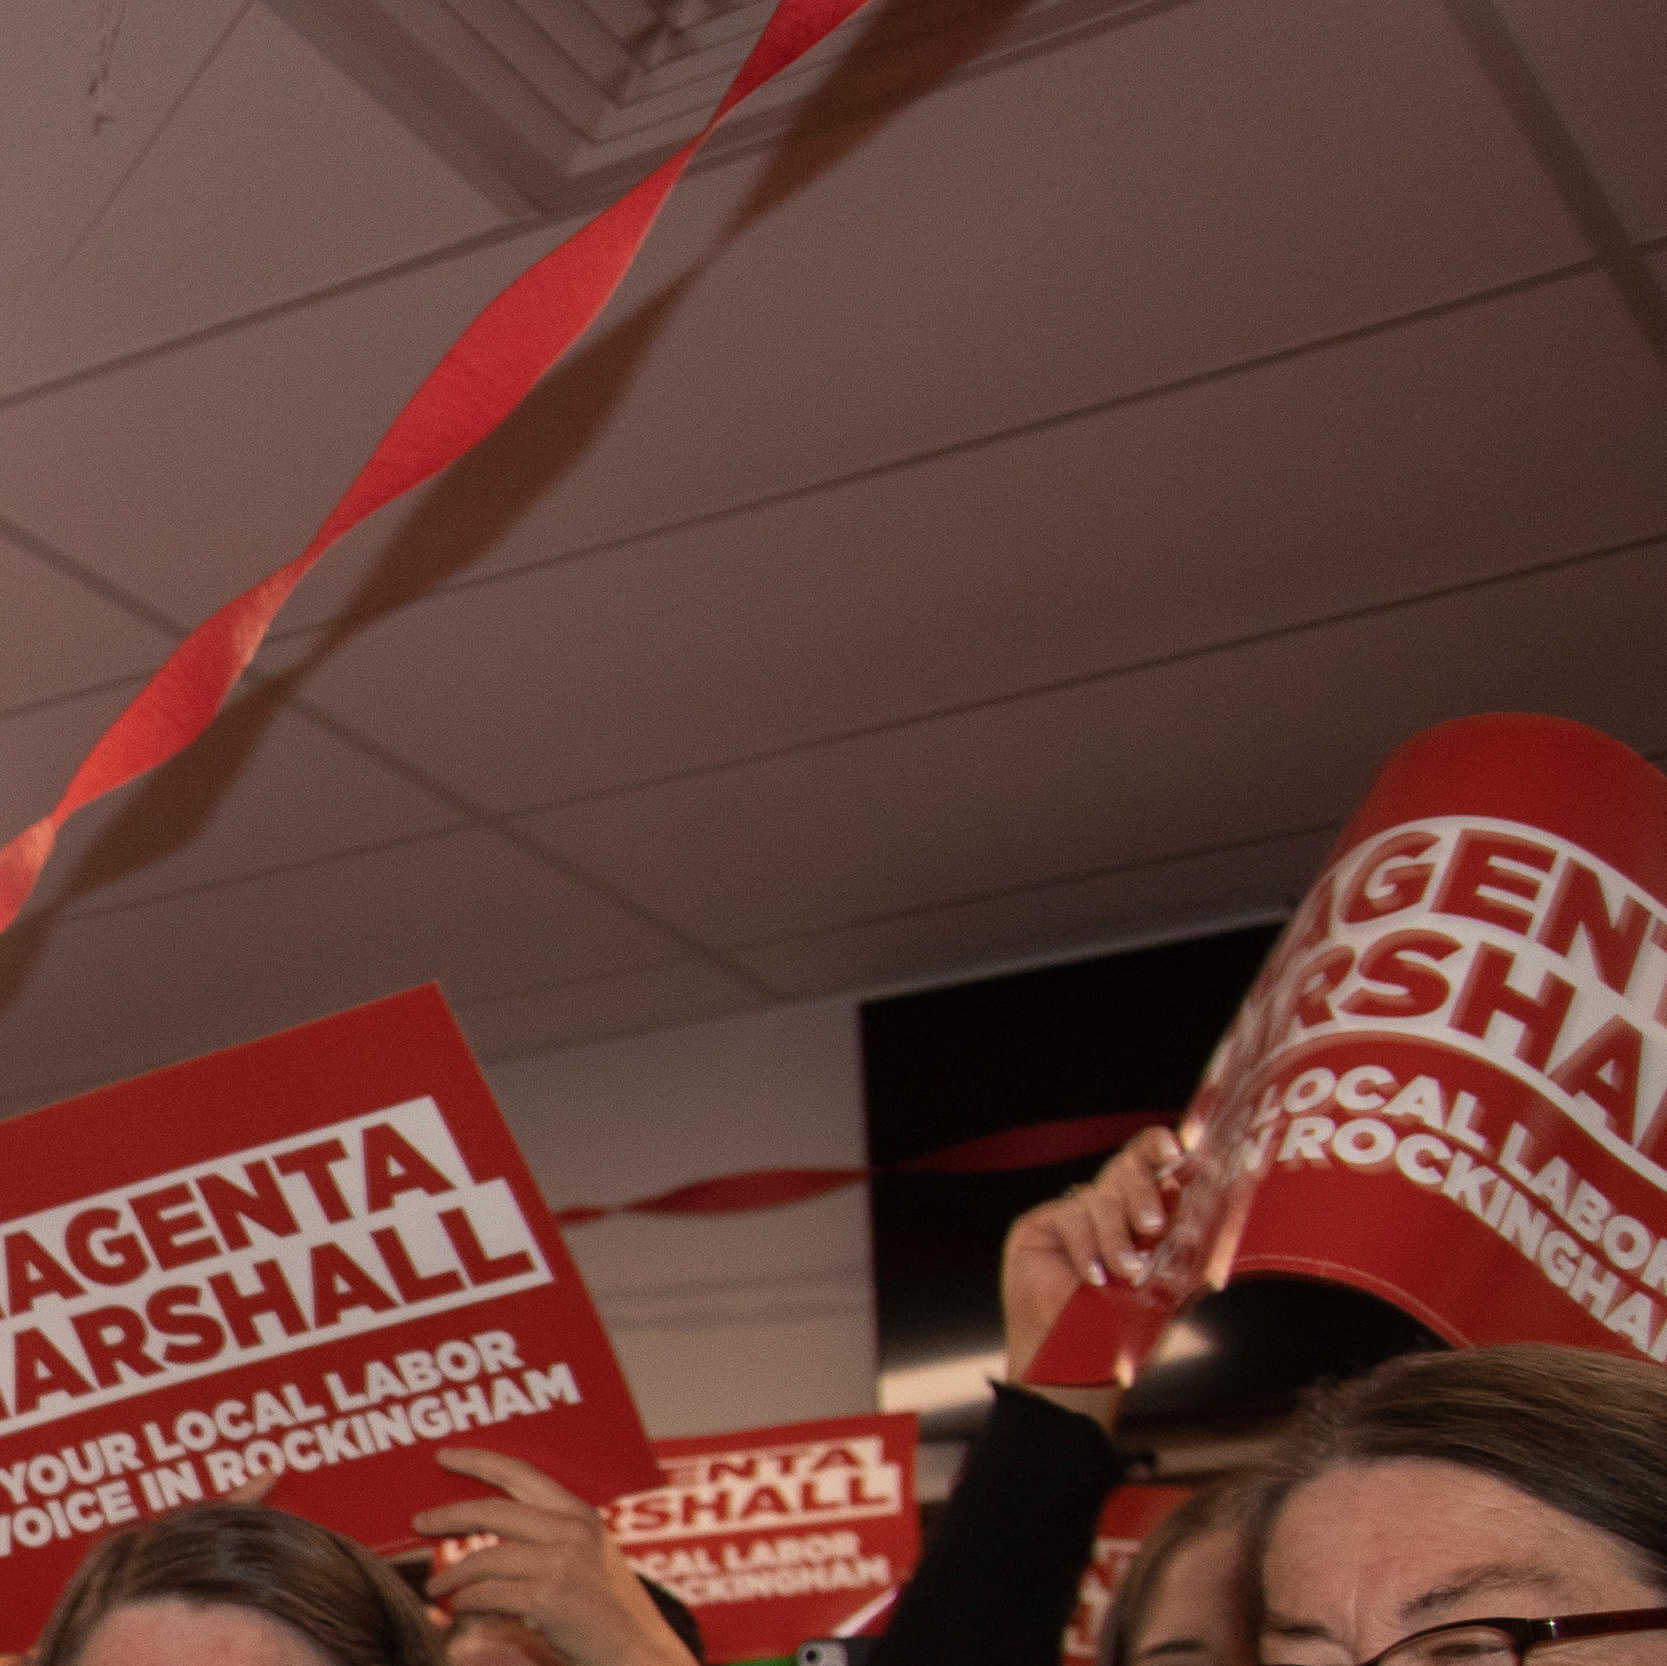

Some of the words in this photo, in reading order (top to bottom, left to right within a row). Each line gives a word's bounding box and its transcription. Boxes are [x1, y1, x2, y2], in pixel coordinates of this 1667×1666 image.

[1255, 1064, 1488, 1152] LOCAL
[141, 1460, 204, 1514] IN
[206, 1362, 582, 1496] ROCKINGHAM
[143, 1384, 326, 1465] LOCAL
[325, 1329, 525, 1409] LABOR
[722, 1530, 861, 1572] LABOR
